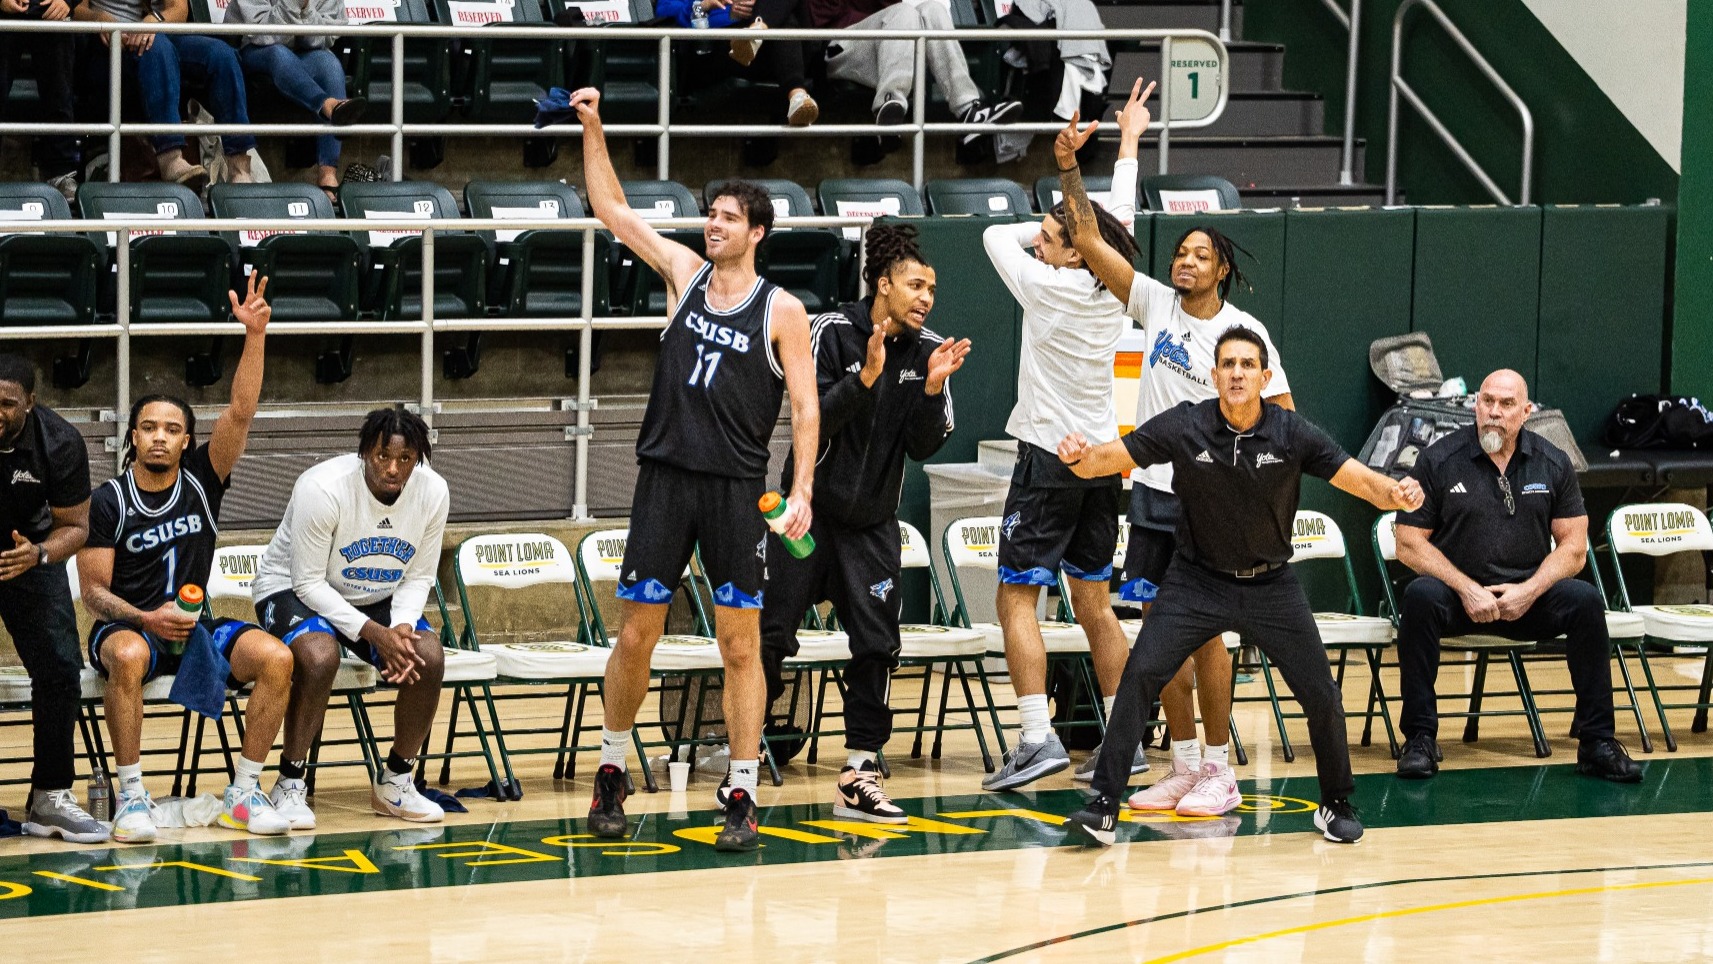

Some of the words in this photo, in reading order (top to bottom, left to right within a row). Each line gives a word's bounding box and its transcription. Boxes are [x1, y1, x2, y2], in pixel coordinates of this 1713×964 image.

[345, 7, 385, 18] ESERVED
[457, 11, 502, 23] RESERVED
[1170, 60, 1218, 68] RESERVED
[1187, 72, 1199, 99] 1
[293, 204, 304, 214] 11
[417, 202, 430, 213] 12
[1168, 200, 1209, 212] RESERVED
[685, 311, 750, 353] CSUSB
[688, 344, 722, 389] 11
[1158, 356, 1208, 387] BASKETBALL
[1625, 513, 1658, 531] POINT
[1660, 510, 1695, 531] LOMA
[125, 514, 202, 553] CSUSB
[962, 526, 996, 545] POINT
[339, 536, 416, 565] TOGETHER
[475, 543, 513, 563] POINT
[516, 540, 555, 562] LOMA
[597, 538, 627, 557] POIN
[162, 546, 176, 595] 1
[219, 554, 258, 575] POINT
[493, 569, 511, 577] SEA
[513, 567, 541, 576] LIONS
